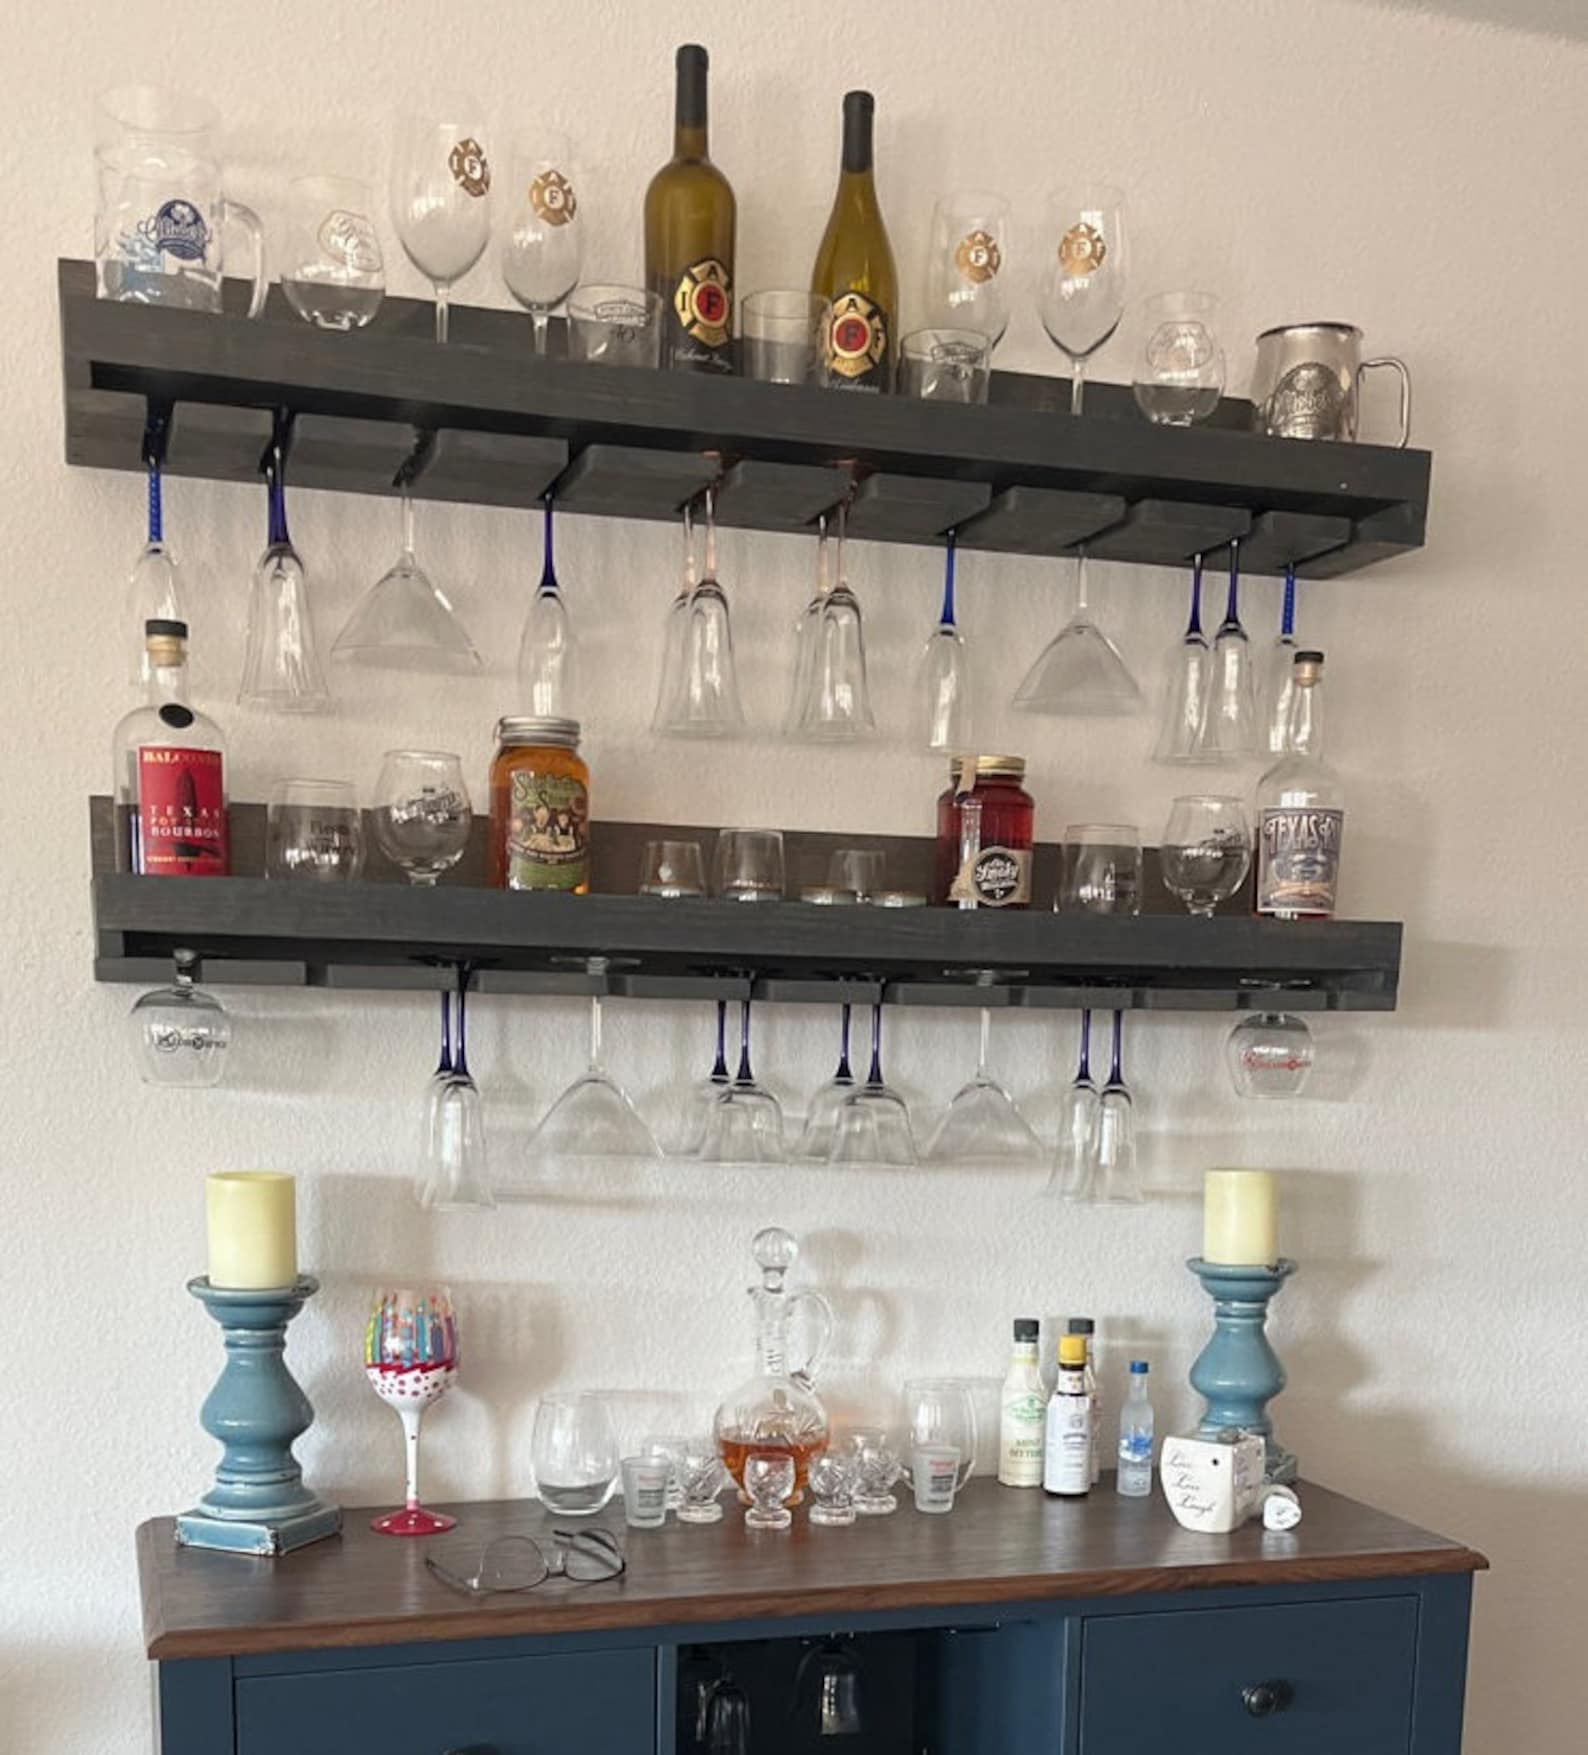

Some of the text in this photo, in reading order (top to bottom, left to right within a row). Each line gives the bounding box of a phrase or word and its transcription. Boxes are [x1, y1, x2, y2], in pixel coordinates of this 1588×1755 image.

[707, 265, 719, 280] A
[706, 290, 720, 314] F
[847, 297, 859, 313] A
[845, 324, 859, 346] F
